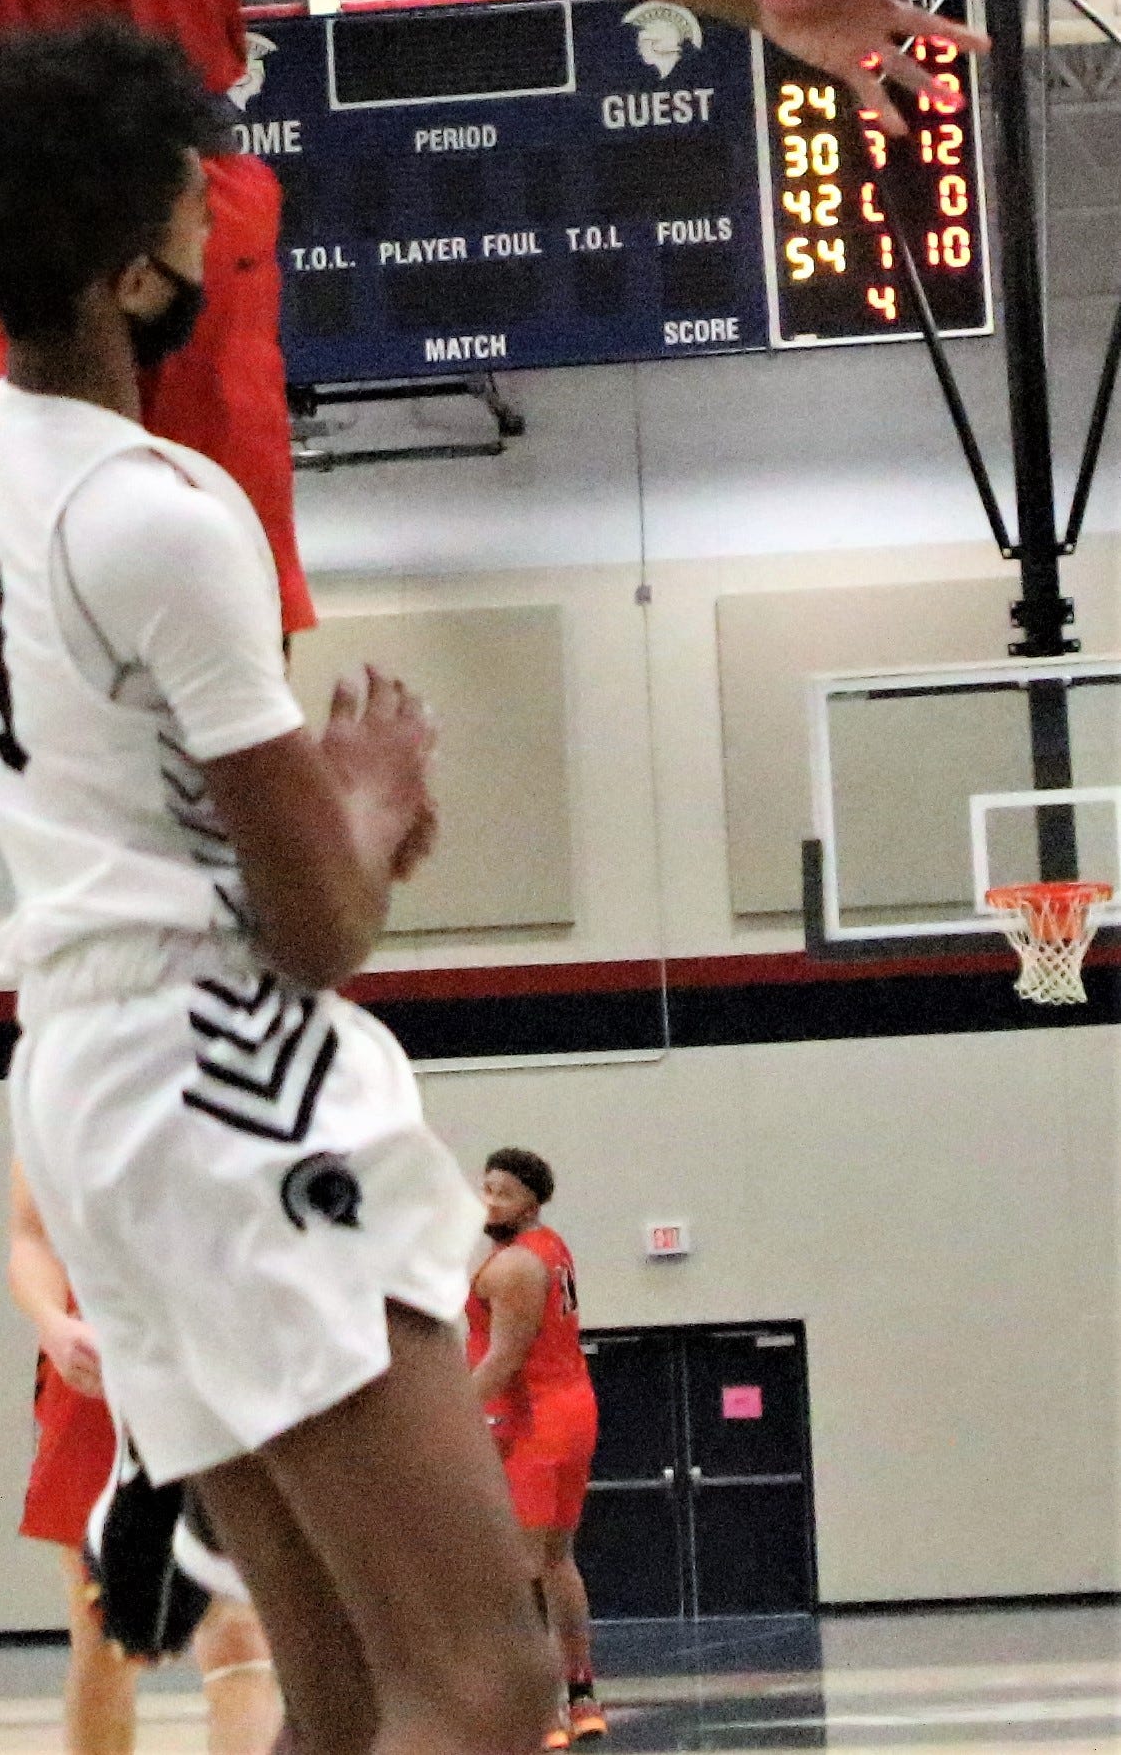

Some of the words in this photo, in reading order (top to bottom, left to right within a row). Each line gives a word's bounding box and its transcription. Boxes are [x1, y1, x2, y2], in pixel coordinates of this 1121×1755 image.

[602, 88, 714, 130] GUEST
[777, 83, 836, 127] 24
[232, 120, 303, 155] OME
[414, 124, 498, 153] PERIOD
[783, 132, 839, 178] 30
[920, 123, 963, 165] 12
[782, 183, 842, 227] 42
[939, 174, 968, 216] 0
[657, 217, 733, 245] FOULS
[291, 246, 356, 271] T.O.L.
[379, 237, 468, 265] PLAYER
[483, 232, 543, 257] FOUL
[785, 236, 846, 280] 54
[927, 225, 971, 268] 10
[866, 286, 897, 320] 4
[424, 333, 507, 363] MATCH
[663, 317, 740, 345] SCORE
